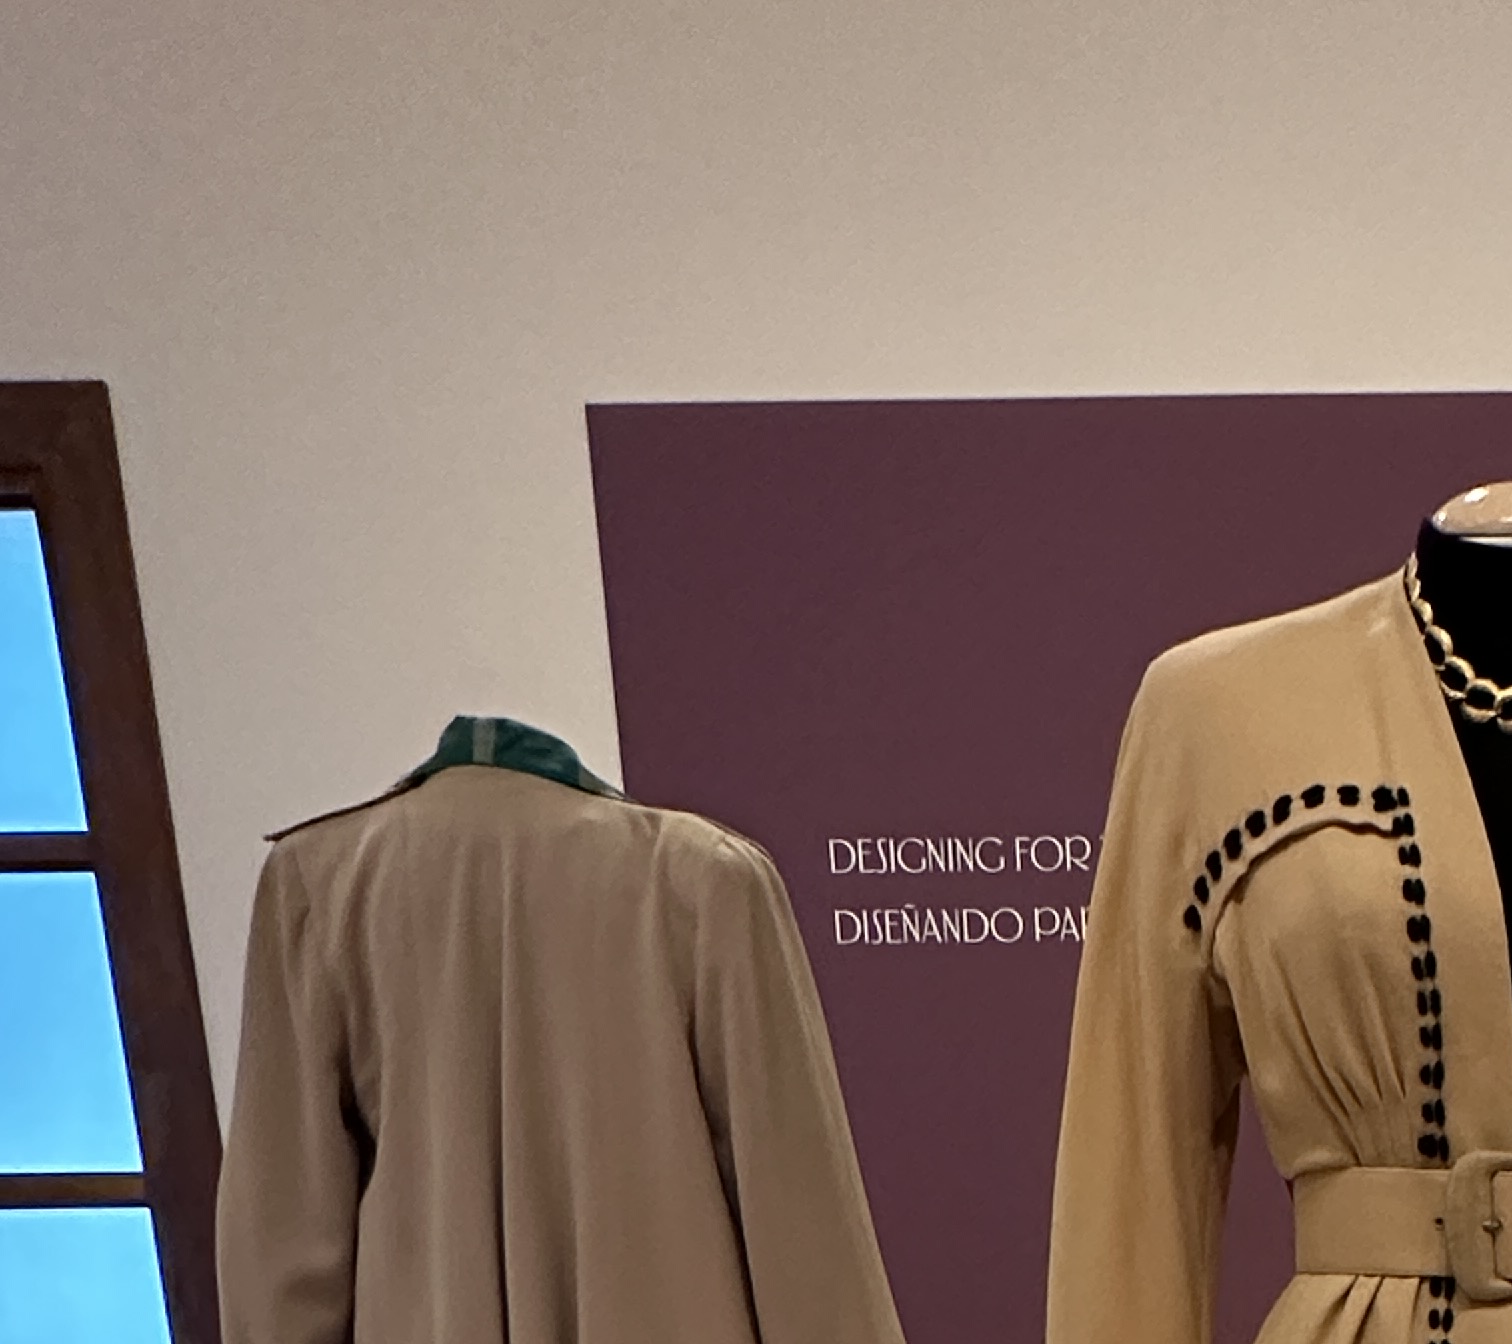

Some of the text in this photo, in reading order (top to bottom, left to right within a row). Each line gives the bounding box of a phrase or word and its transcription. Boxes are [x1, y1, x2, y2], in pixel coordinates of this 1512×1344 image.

[828, 834, 1092, 874] DESIGNING FOR
[834, 903, 1024, 945] DISEÑANDO
